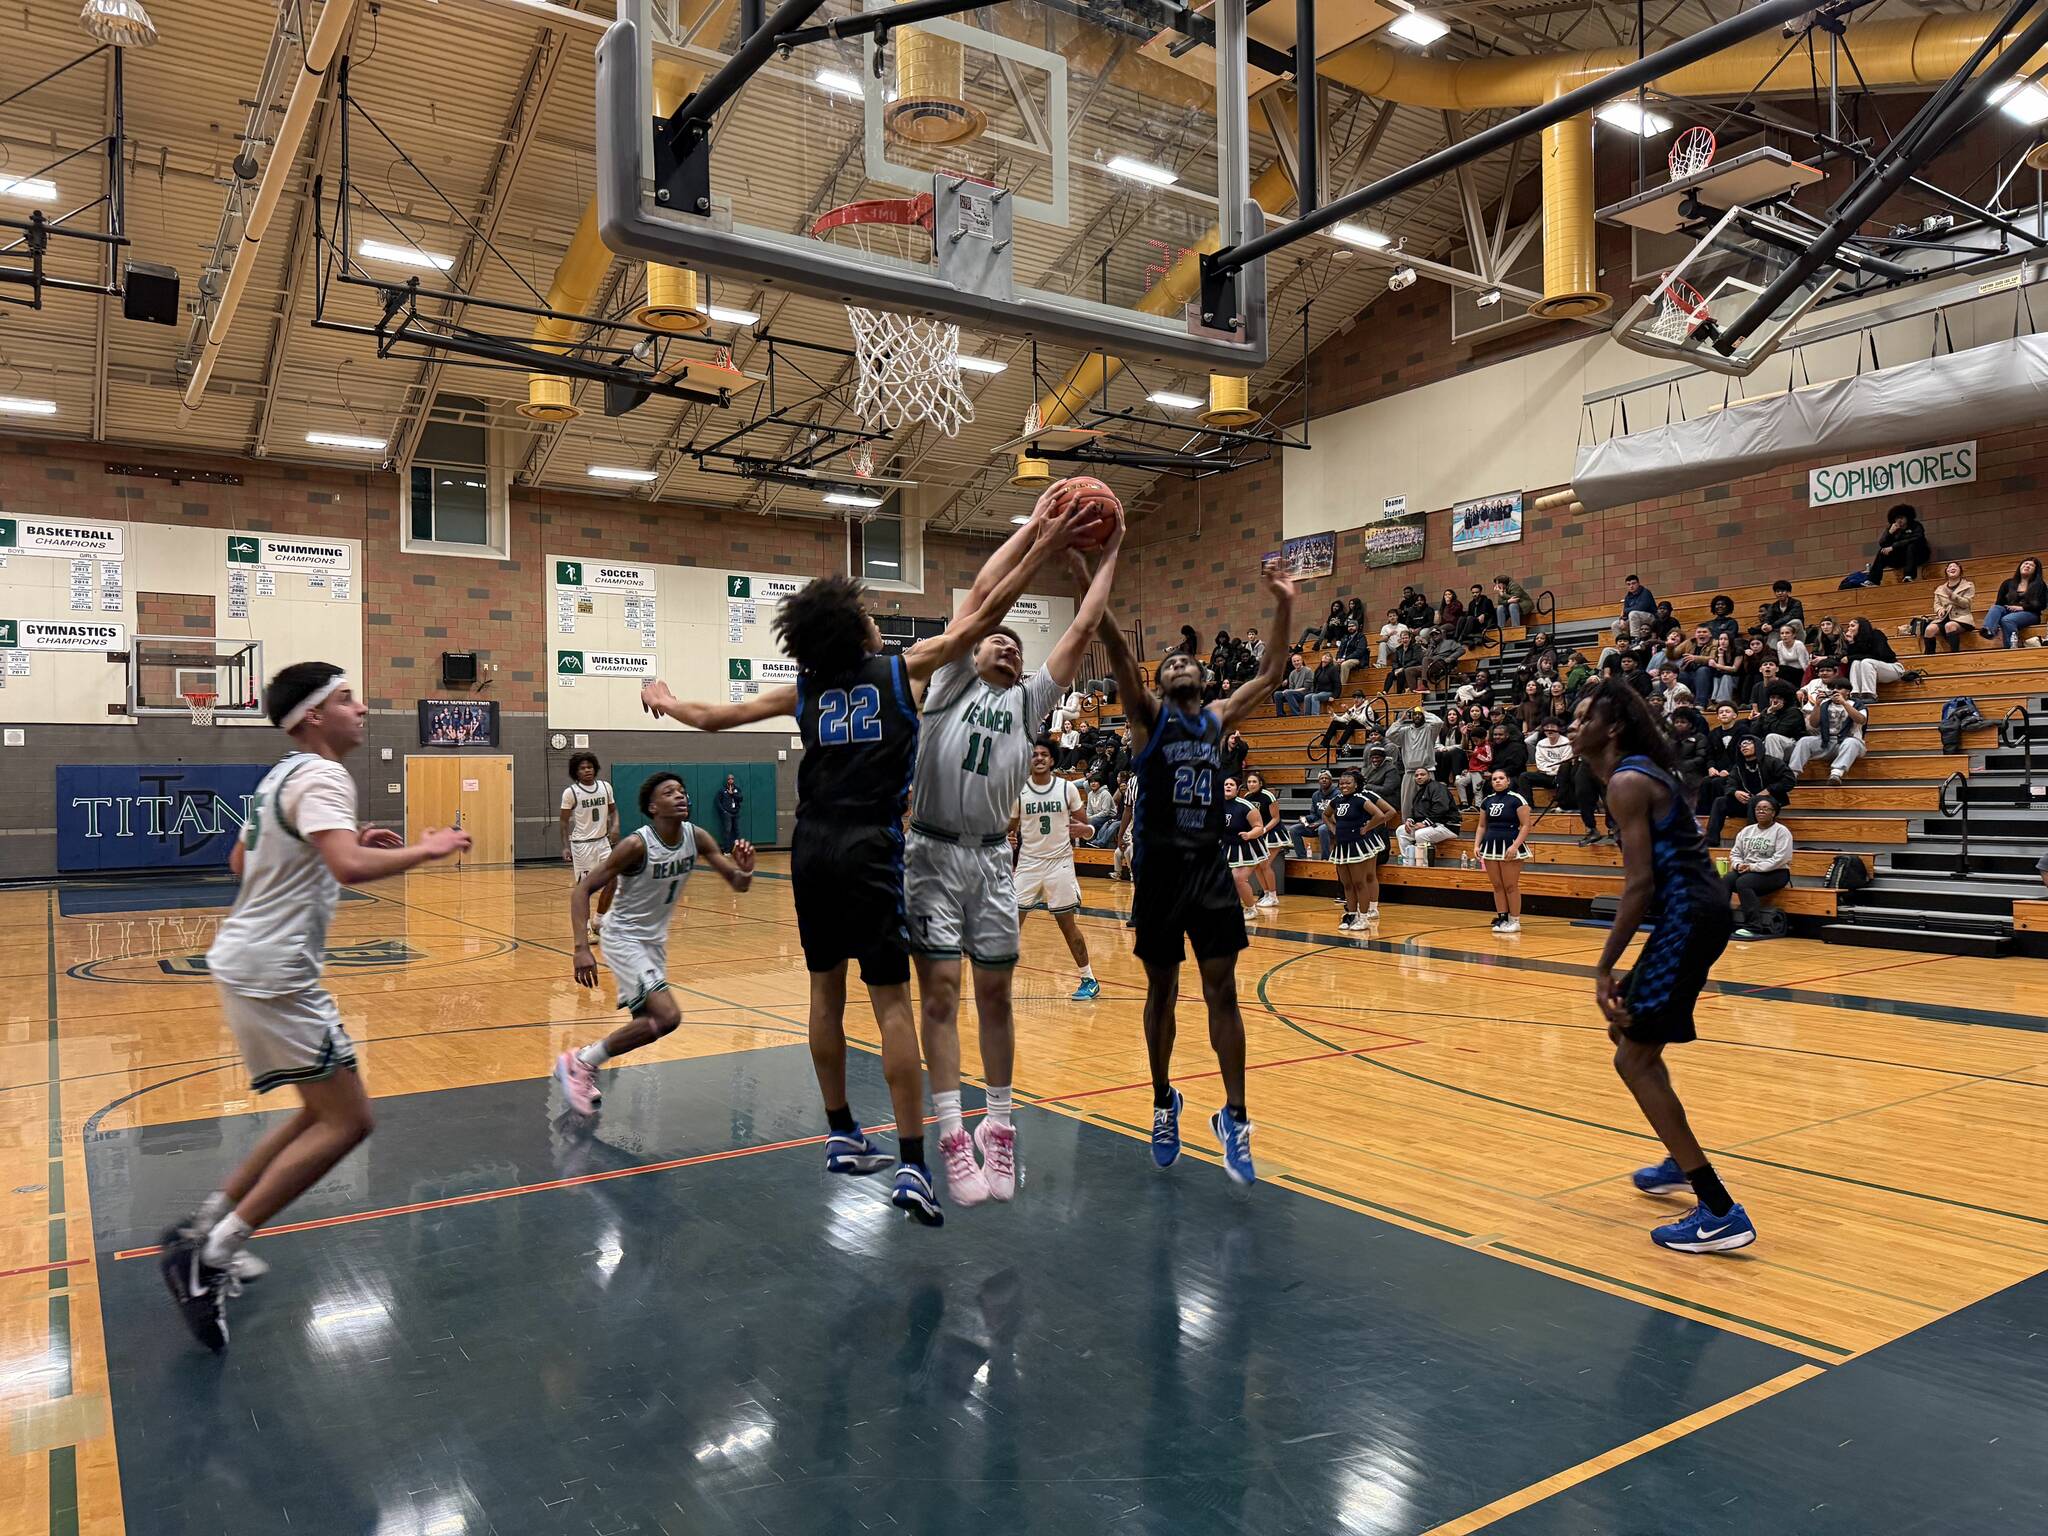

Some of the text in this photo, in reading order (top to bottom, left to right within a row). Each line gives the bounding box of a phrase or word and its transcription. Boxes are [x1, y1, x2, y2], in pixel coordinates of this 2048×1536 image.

[1814, 449, 1972, 502] SOPHOMORES
[1385, 498, 1404, 507] Beamer
[1384, 508, 1405, 518] Students
[26, 526, 114, 540] BASKETBALL
[36, 538, 106, 548] CHAMPIONS
[268, 544, 342, 556] SWIMMING
[274, 554, 336, 564] CHAMPIONS
[600, 569, 638, 578] SOCCER
[595, 577, 644, 586] CHAMPIONS
[768, 582, 796, 591] TRACK
[26, 625, 116, 637] GYMNASTICS
[37, 637, 108, 645] CHAMPIONS
[592, 656, 648, 665] WRESTLING
[819, 684, 882, 746] 22
[962, 732, 992, 776] 11
[1173, 766, 1212, 806] 24
[582, 797, 605, 808] BEAMER
[1026, 801, 1062, 814] BEAMER
[1040, 816, 1051, 834] 3
[665, 880, 678, 904] 1
[919, 916, 932, 938] T
